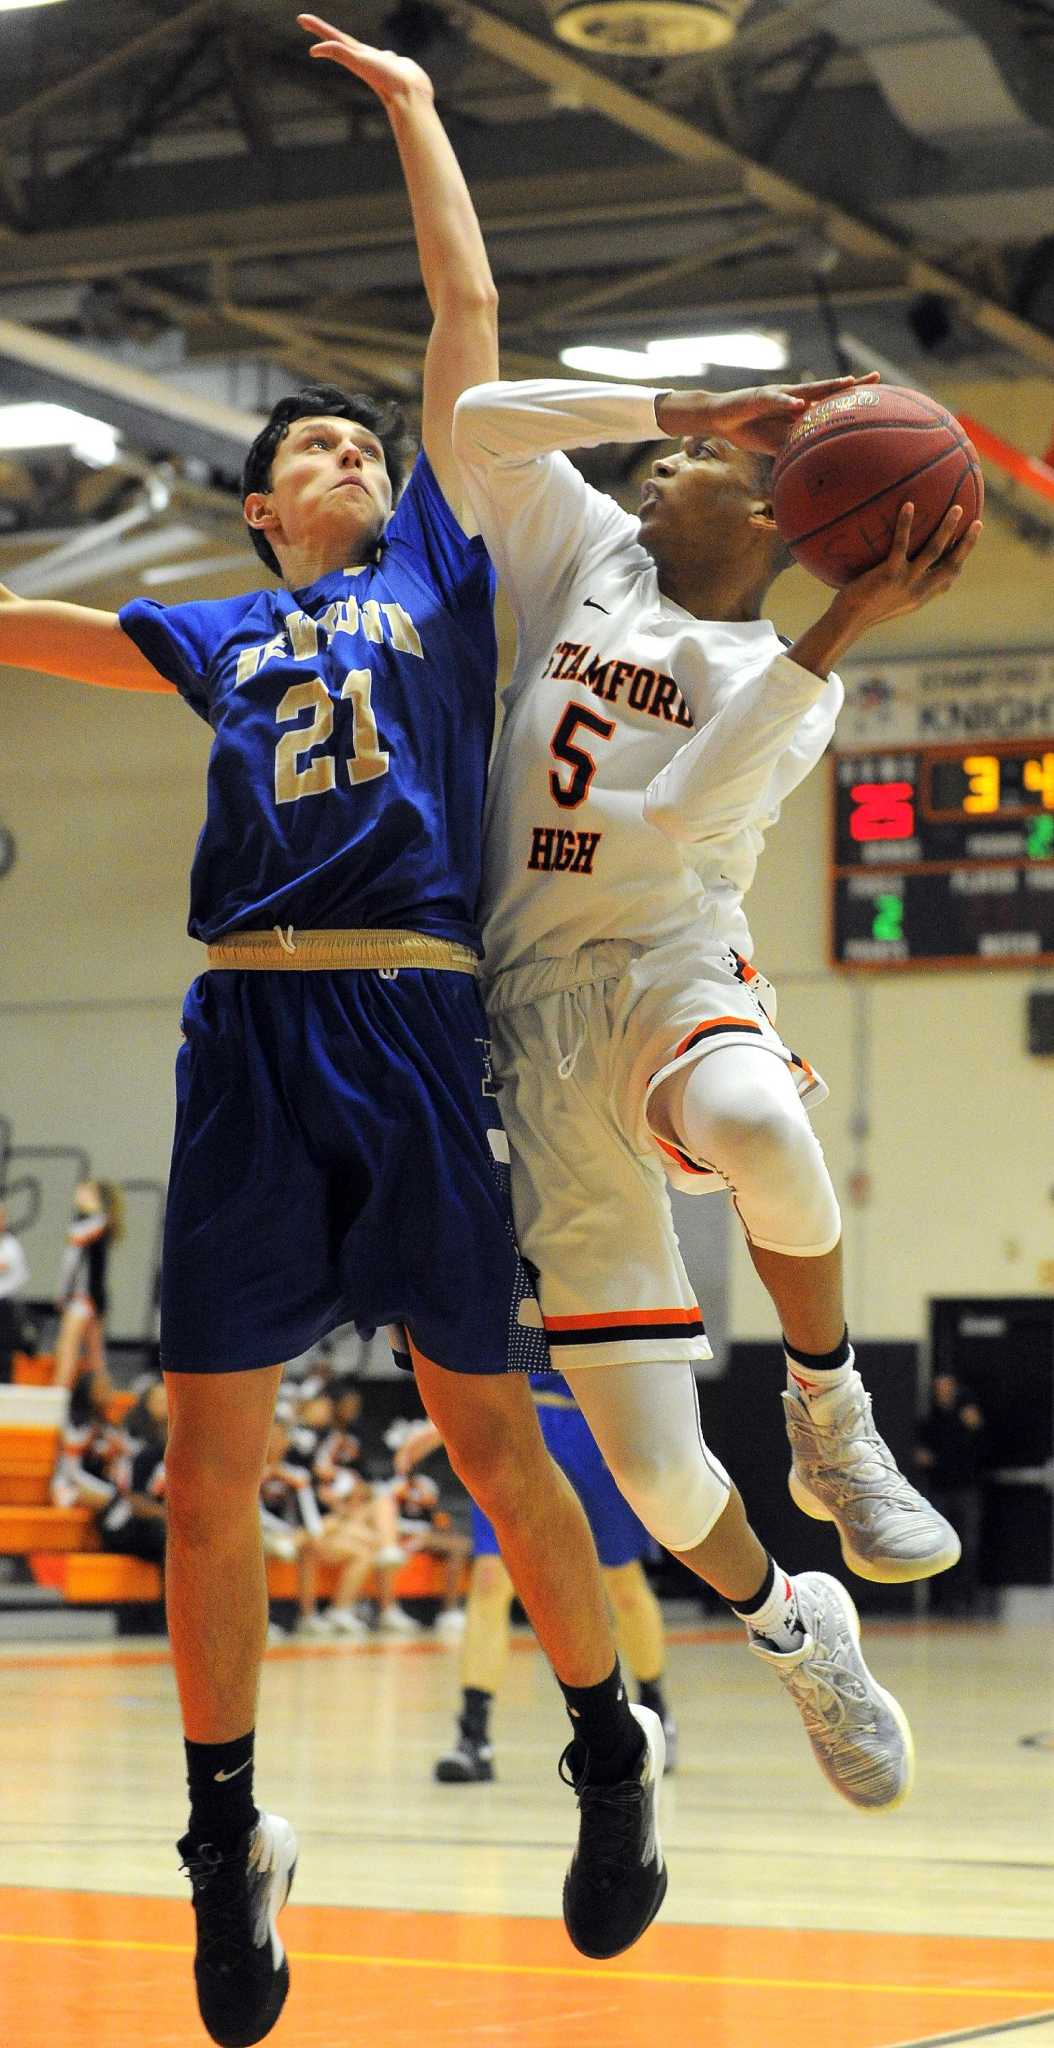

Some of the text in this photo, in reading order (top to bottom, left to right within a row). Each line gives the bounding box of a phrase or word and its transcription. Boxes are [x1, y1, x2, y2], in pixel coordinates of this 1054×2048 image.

[541, 640, 694, 728] TAMFORD
[274, 668, 389, 805] 21
[549, 700, 617, 810] 5
[527, 827, 602, 875] HGH
